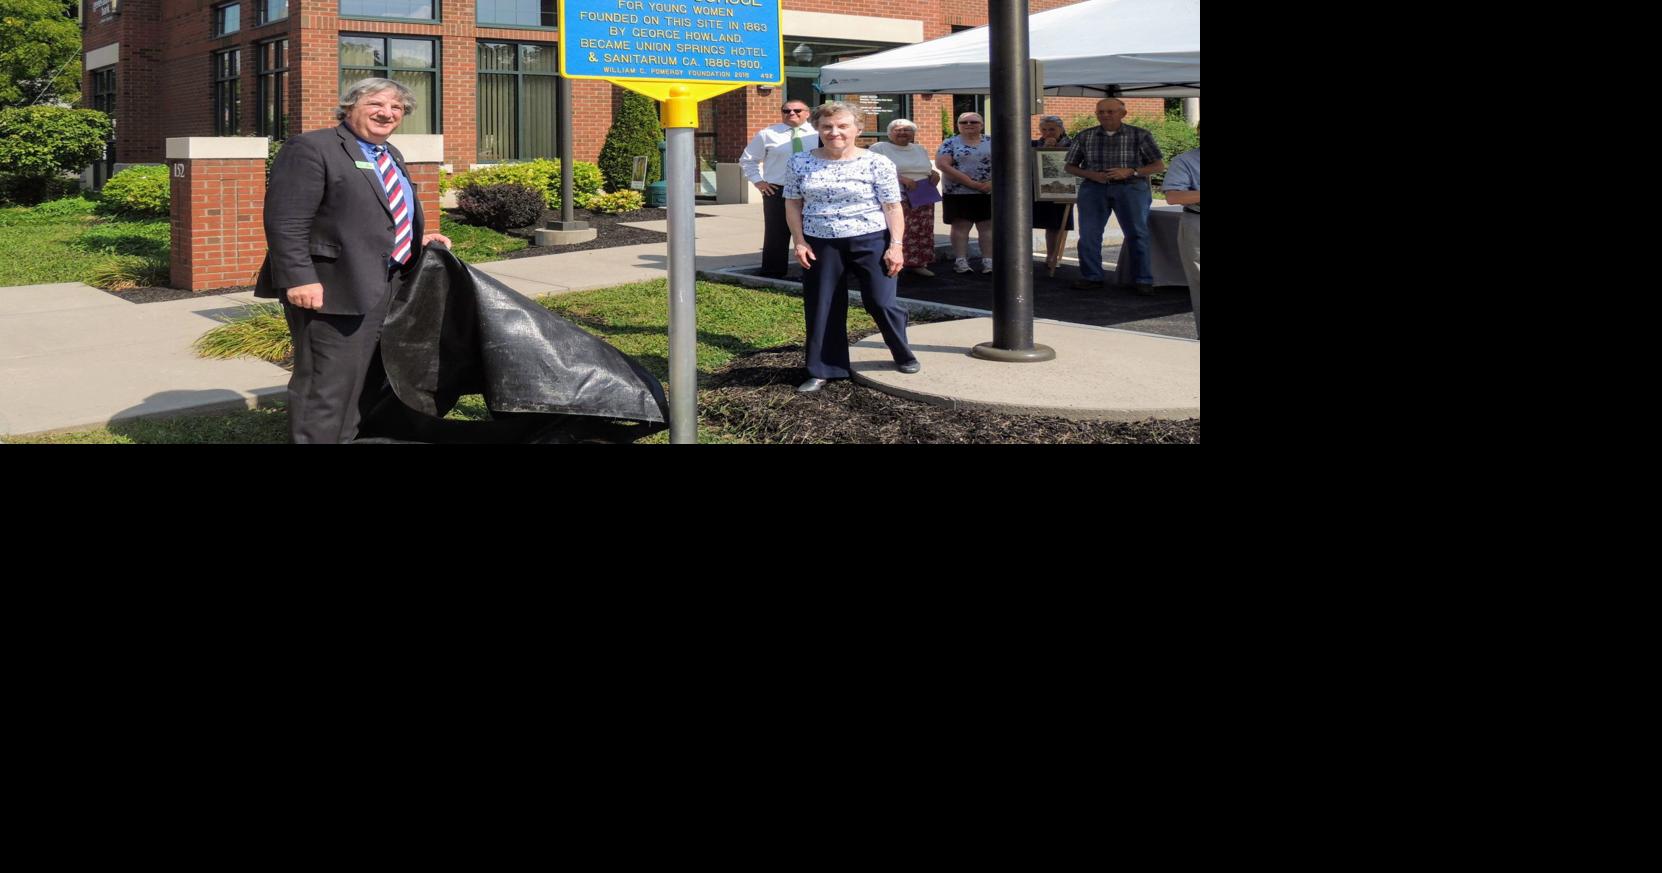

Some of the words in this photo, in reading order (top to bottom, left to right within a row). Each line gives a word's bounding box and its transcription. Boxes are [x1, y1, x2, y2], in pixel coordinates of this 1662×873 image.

[618, 0, 644, 10] FOR
[649, 2, 687, 14] YOUNG
[693, 5, 734, 17] WOMEN
[580, 11, 638, 24] FOUNDED
[643, 15, 659, 25] ON
[665, 16, 691, 27] THIS
[697, 19, 724, 29] SITE
[729, 21, 739, 30] IN
[743, 22, 768, 32] 1863
[609, 26, 625, 36] BY
[632, 27, 680, 40] GEORGE
[685, 31, 743, 43] HOWLAND.
[580, 38, 630, 50] BECAME
[636, 41, 671, 51] UNION
[676, 43, 725, 55] SPRINGS
[731, 46, 767, 57] HOTEL
[588, 51, 598, 62] &
[604, 53, 677, 65] SANITARIUM
[682, 56, 700, 66] CA.
[603, 66, 636, 74] WILLIAM
[651, 67, 683, 76] POMEROY
[688, 69, 730, 78] FOUNDATION
[174, 163, 185, 178] 152
